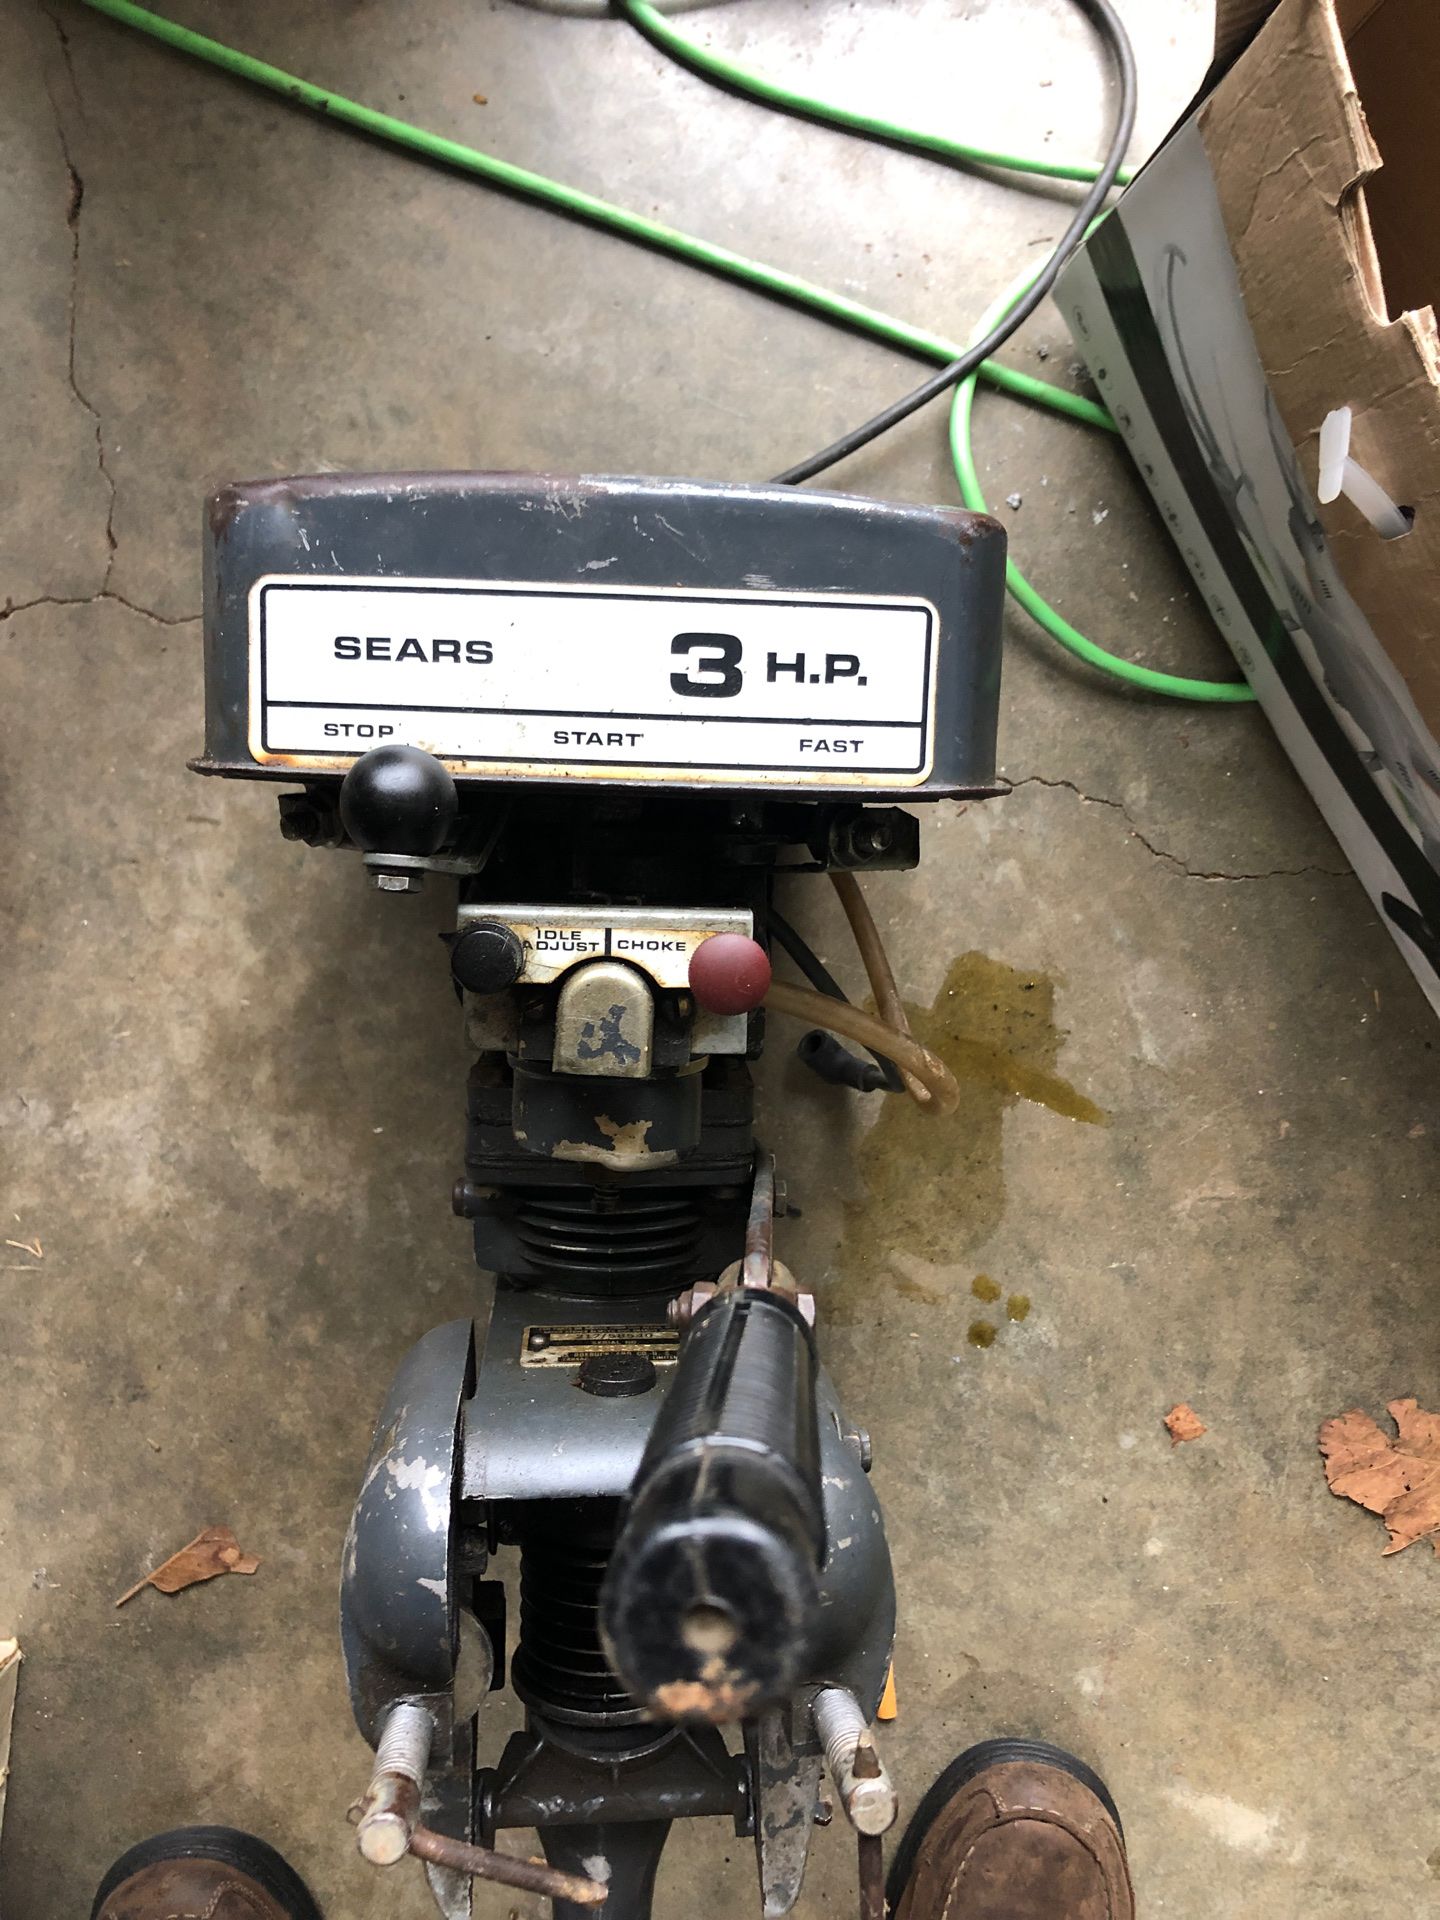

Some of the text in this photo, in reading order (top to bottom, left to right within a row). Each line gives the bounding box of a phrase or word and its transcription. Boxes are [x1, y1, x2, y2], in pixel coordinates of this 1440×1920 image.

[334, 636, 493, 665] SEARS
[670, 632, 868, 698] 3 H.P.
[324, 723, 394, 738] STOP
[553, 731, 643, 747] START
[799, 739, 864, 753] FAST
[536, 929, 582, 941] IDLE
[522, 940, 600, 952] ADJUST
[617, 939, 687, 952] CHOKE
